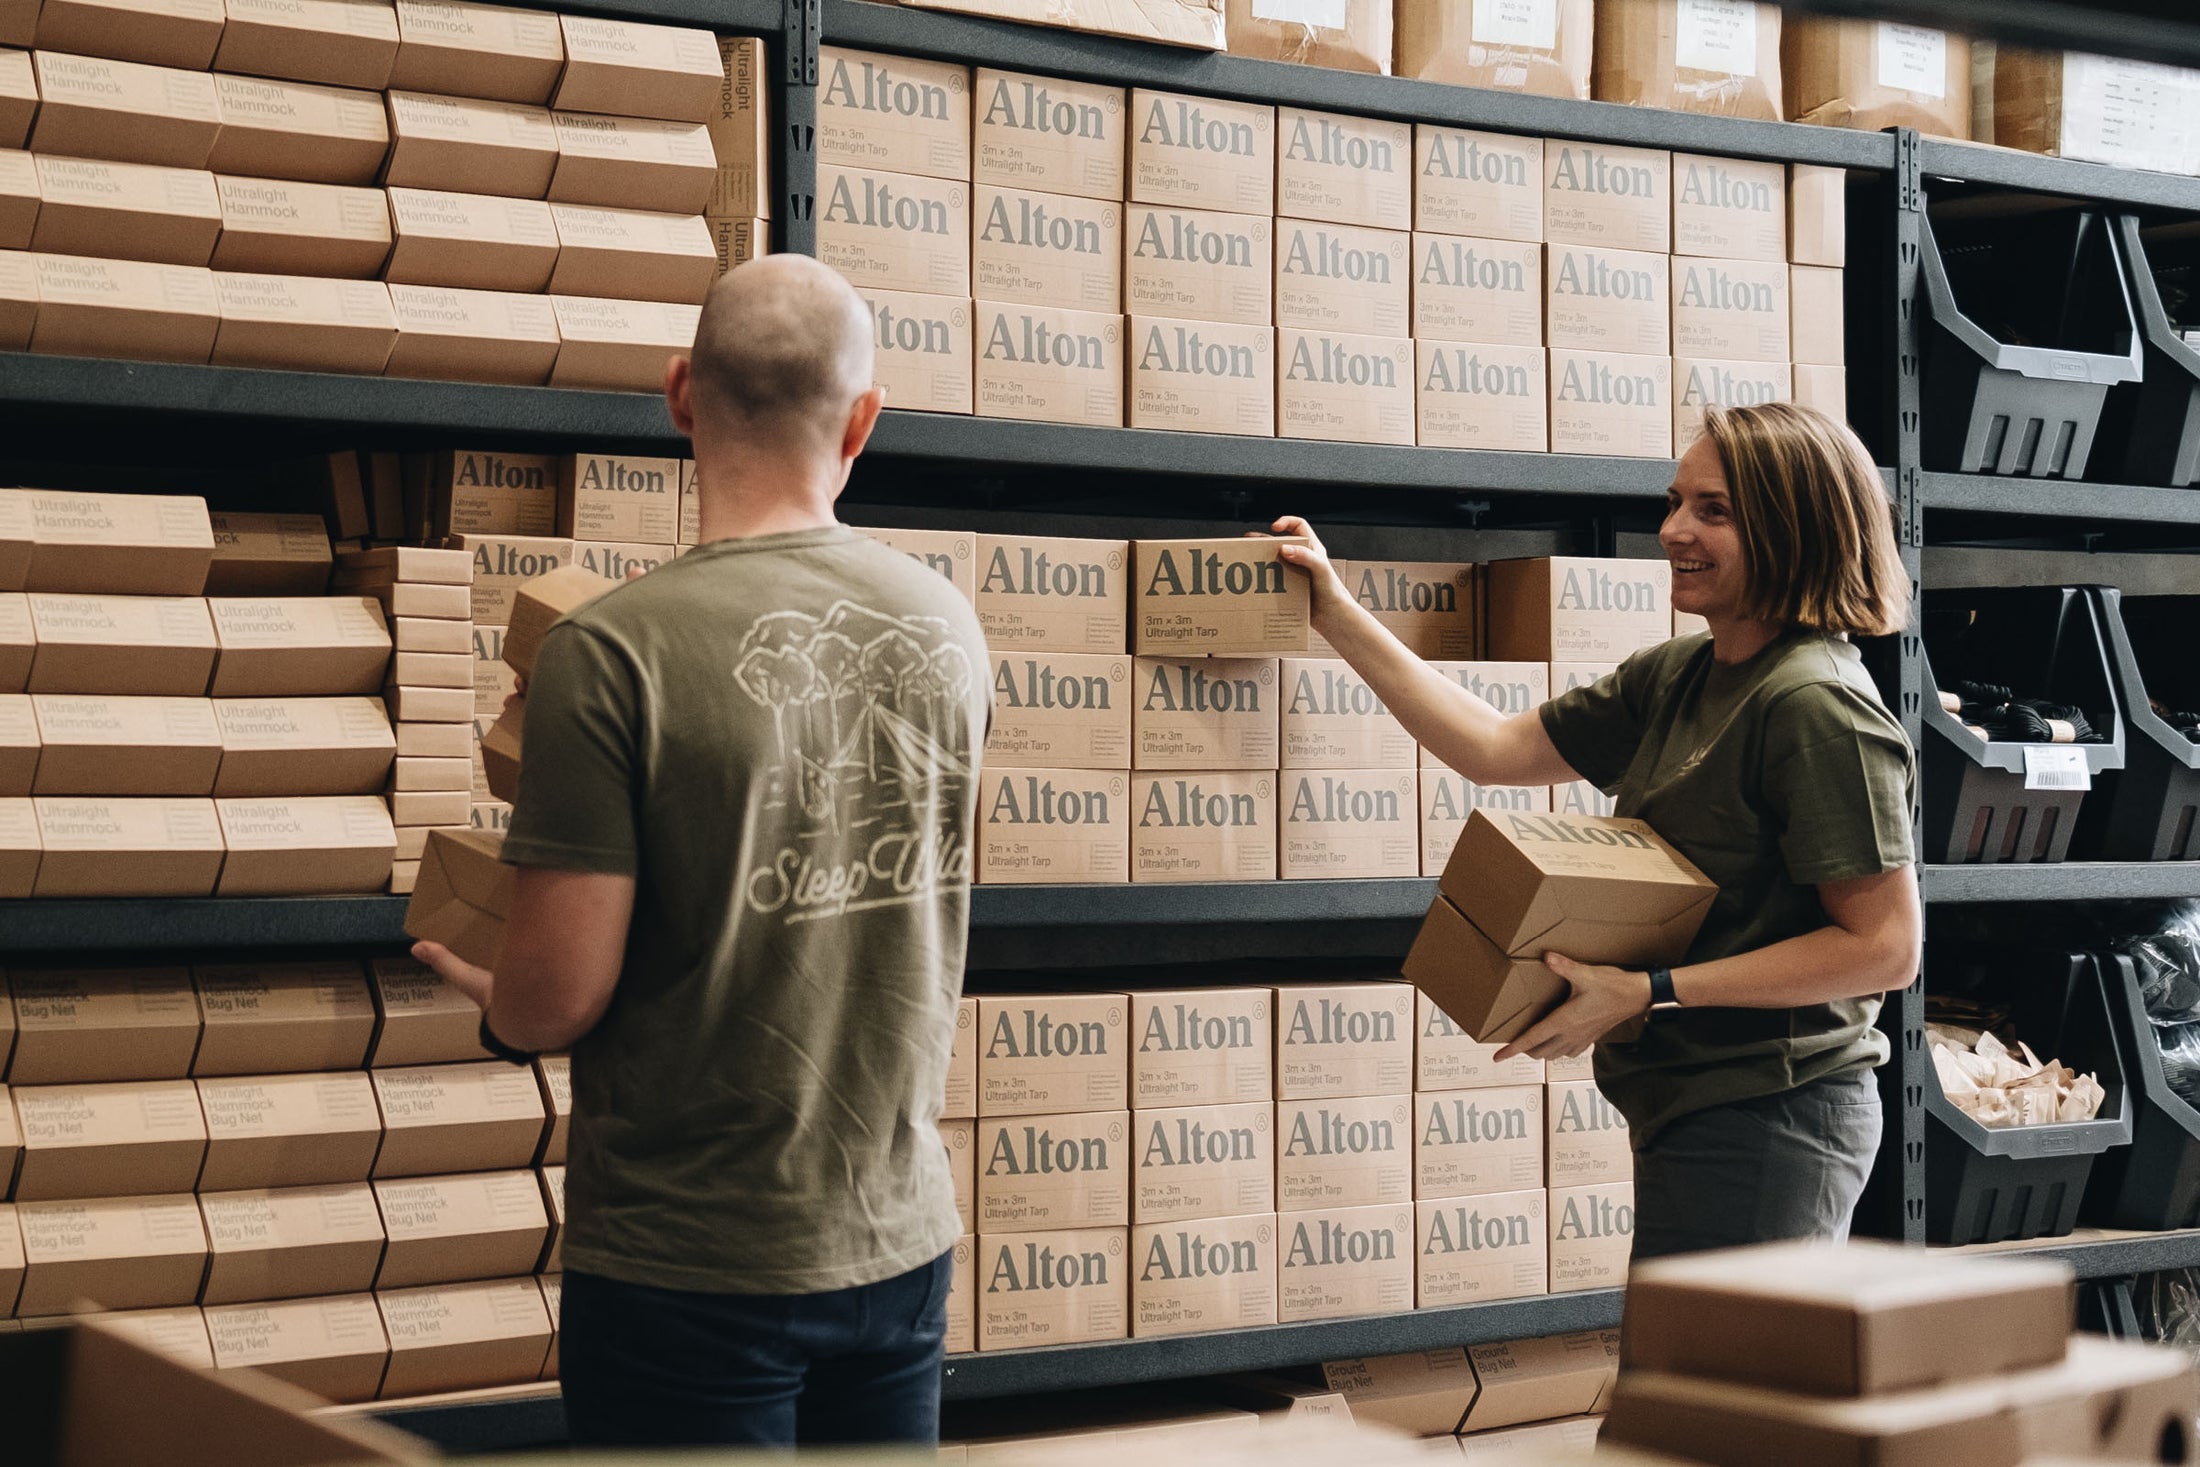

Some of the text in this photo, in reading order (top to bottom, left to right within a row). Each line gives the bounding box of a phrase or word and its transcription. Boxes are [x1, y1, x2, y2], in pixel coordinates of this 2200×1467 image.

[403, 15, 474, 34] Hammock
[569, 34, 637, 52] Hammock
[219, 79, 285, 100] Ultralight
[722, 42, 734, 120] Hammock
[737, 42, 751, 111] Ultralight
[822, 59, 949, 120] Alton
[222, 97, 297, 117] Hammock
[556, 115, 617, 134] Ultralight
[983, 79, 1105, 140] Alton
[1139, 99, 1255, 156] Alton
[822, 126, 838, 138] 3m
[849, 128, 865, 140] 3m
[822, 138, 888, 157] Ultralight Tarp
[1286, 115, 1393, 172] Alton
[982, 157, 1045, 176] Ultralight Tarp
[1423, 130, 1527, 186] Alton
[1551, 148, 1653, 198] Alton
[222, 184, 287, 202] Ultralight
[823, 174, 949, 235] Alton
[1139, 175, 1199, 191] Ultralight Tarp
[1681, 160, 1772, 212] Alton
[225, 201, 299, 219] Hammock
[980, 195, 1101, 254] Alton
[1588, 222, 1604, 233] Tarp
[719, 222, 731, 277] Hamm
[735, 222, 748, 265] Ultral
[1134, 212, 1252, 267] Alton
[1284, 230, 1391, 283] Alton
[978, 272, 1043, 291] Ultralight Tarp
[1420, 241, 1524, 292] Alton
[1554, 252, 1653, 302] Alton
[1679, 267, 1774, 313] Alton
[866, 300, 952, 354] ton
[983, 314, 1104, 370] Alton
[1139, 325, 1255, 378] Alton
[1286, 337, 1395, 388] Alton
[1424, 349, 1529, 397] Alton
[1558, 361, 1656, 406] Alton
[1680, 365, 1775, 407] Alton
[1139, 402, 1199, 417] Ultralight Tarp
[456, 455, 544, 490] Alton
[580, 459, 665, 493] Alton
[473, 543, 559, 577] Alton
[981, 546, 1108, 598] Alton
[1145, 549, 1287, 596] Alton
[1357, 568, 1457, 613] Alton
[1557, 567, 1655, 612] Alton
[216, 605, 283, 621] Ultralight
[221, 619, 296, 633] Hammock
[1145, 616, 1163, 626] 3m
[1175, 615, 1192, 625] 3m
[1145, 626, 1218, 639] Ultralight Tarp
[995, 659, 1110, 709] Alton
[1143, 664, 1260, 712] Alton
[223, 720, 300, 735] Hammock
[1142, 742, 1204, 755] Ultralight Tarp
[989, 776, 1109, 824] Alton
[1139, 781, 1256, 827] Alton
[1288, 777, 1399, 822] Alton
[1507, 815, 1656, 850] Alton
[750, 849, 868, 915] Sleep
[987, 855, 1050, 868] Ultralight Tarp
[1139, 857, 1200, 870] Ultralight Tarp
[20, 1004, 77, 1018] Bug Net
[206, 996, 259, 1010] Bug Net
[1285, 998, 1397, 1047] Alton
[986, 1009, 1107, 1060] Alton
[1140, 1003, 1252, 1052] Alton
[378, 1074, 434, 1089] Ultralight
[382, 1087, 445, 1100] Hammock
[985, 1078, 1001, 1089] 3m
[1010, 1077, 1026, 1088] 3m
[985, 1088, 1048, 1102] Ultralight Tarp
[211, 1112, 263, 1126] Bug Net
[386, 1100, 435, 1114] Bug Net
[1423, 1099, 1527, 1146] Alton
[1555, 1088, 1628, 1133] Alt
[986, 1126, 1108, 1175] Alton
[1142, 1117, 1255, 1167] Alton
[1285, 1109, 1395, 1157] Alton
[384, 1199, 448, 1211] Hammock
[985, 1205, 1049, 1219] Ultralight Tarp
[1284, 1185, 1342, 1199] Ultralight Tarp
[388, 1212, 438, 1226] Bug Net
[1424, 1208, 1531, 1255] Alton
[1555, 1195, 1634, 1240] Alto
[1142, 1231, 1257, 1282] Alton
[1285, 1220, 1396, 1267] Alton
[987, 1243, 1108, 1293] Alton
[1141, 1309, 1202, 1324] Ultralight Tarp
[217, 1337, 269, 1352] Bug Net
[1478, 1358, 1517, 1373] Bug Net
[1327, 1362, 1367, 1377] Ground
[1331, 1376, 1374, 1391] Bug Net
